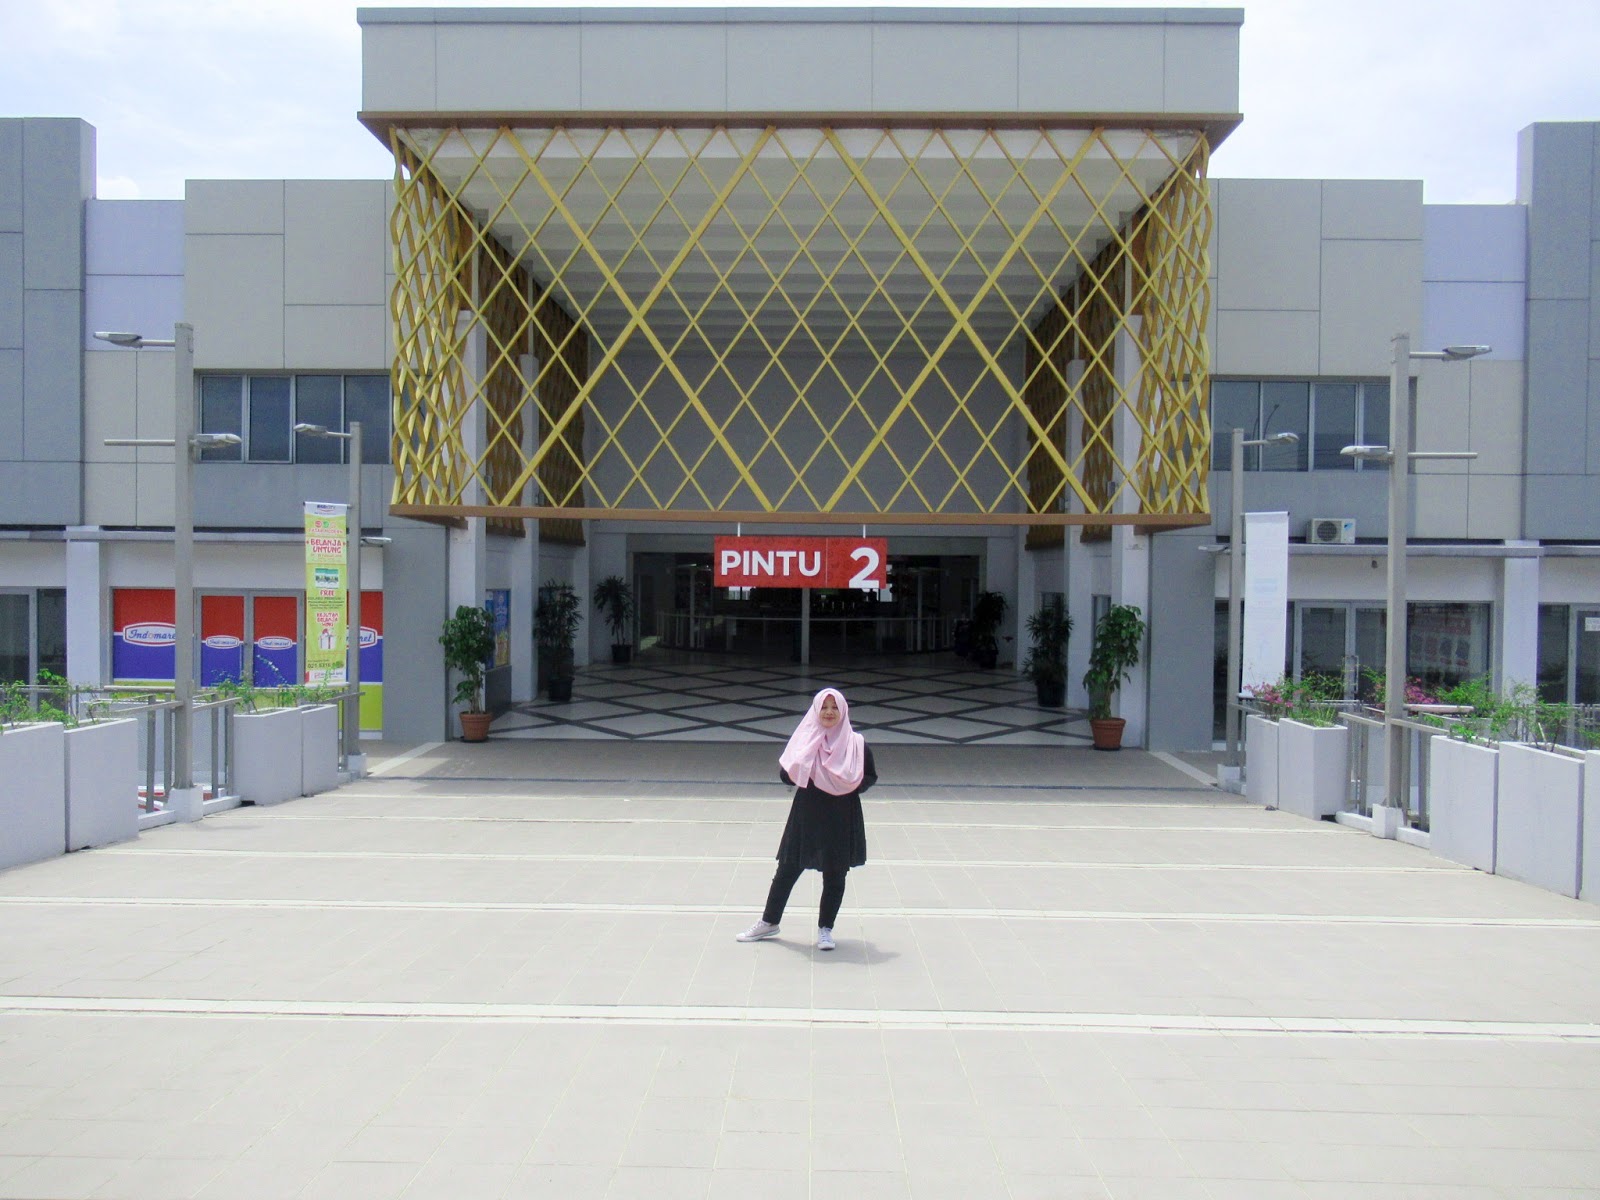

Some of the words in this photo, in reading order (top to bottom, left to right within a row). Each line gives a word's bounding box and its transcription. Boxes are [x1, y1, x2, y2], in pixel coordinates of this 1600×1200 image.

[310, 538, 342, 546] BELANJA
[312, 546, 342, 554] UNTUNG
[721, 550, 821, 577] PINTU
[848, 547, 879, 588] 2
[128, 629, 176, 639] Indomare
